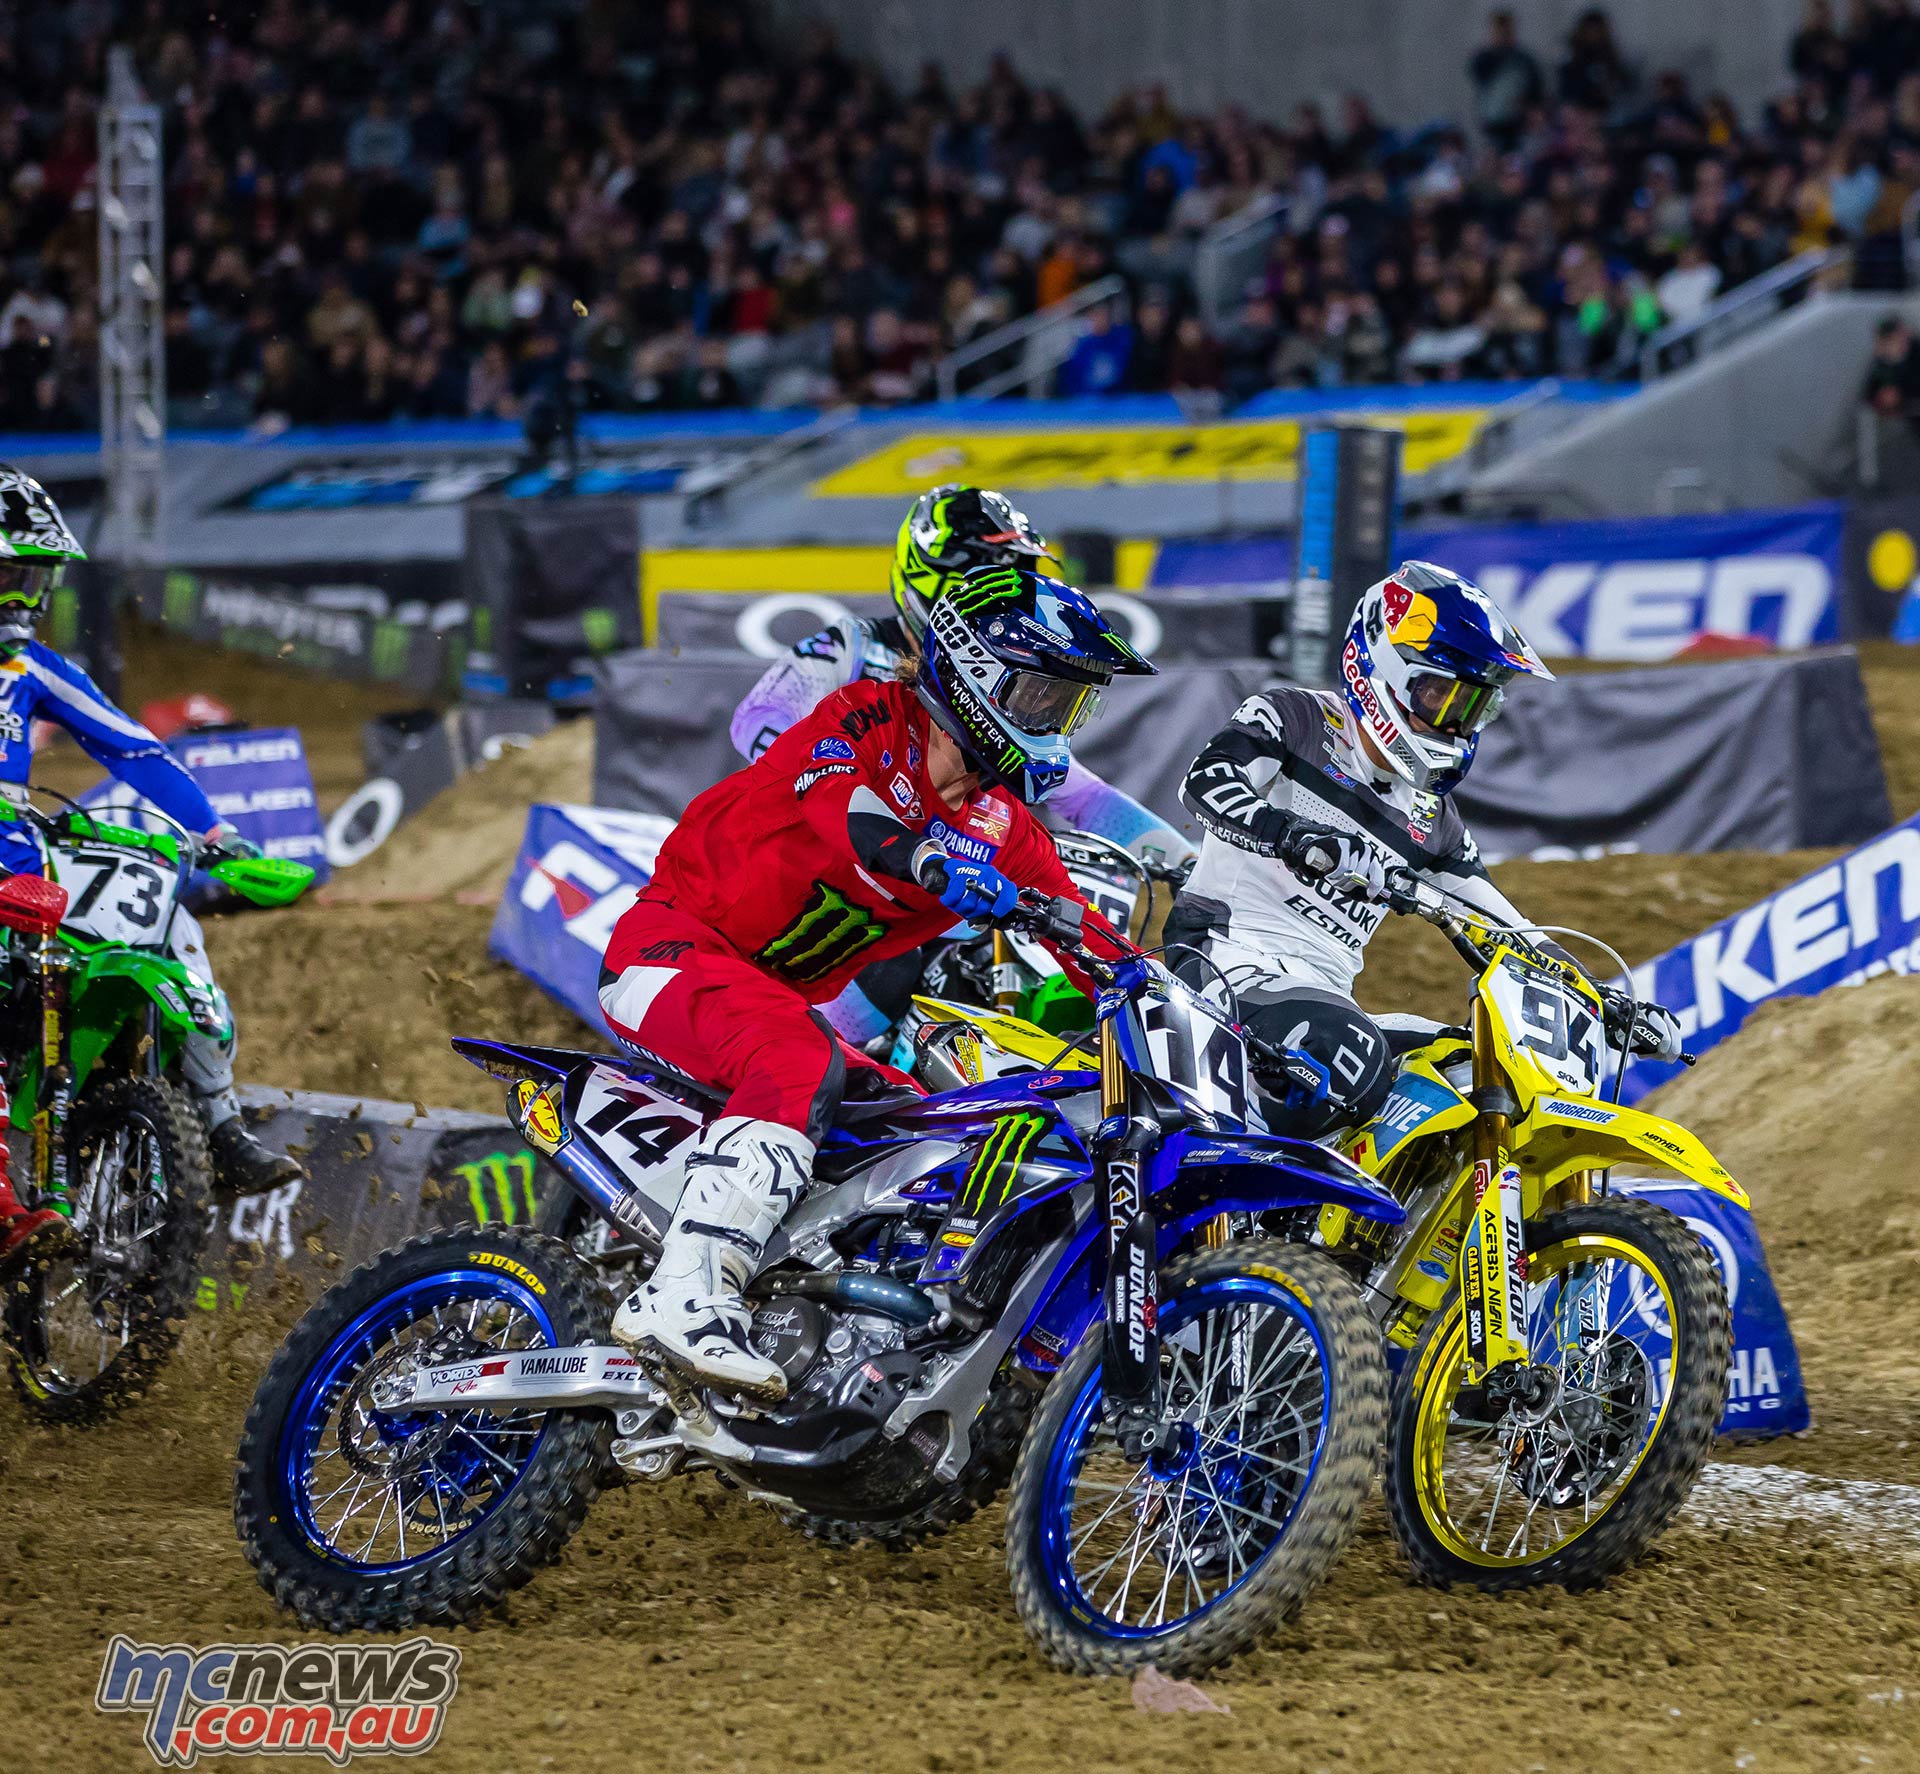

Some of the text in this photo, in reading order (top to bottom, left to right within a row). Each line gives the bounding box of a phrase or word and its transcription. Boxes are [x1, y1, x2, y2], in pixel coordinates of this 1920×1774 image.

[1474, 554, 1839, 661] KEN
[930, 600, 989, 681] 100%
[950, 680, 1006, 750] MONSTER
[951, 698, 990, 746] ENERGY
[893, 780, 914, 804] 100%
[943, 830, 991, 862] YAMAHA
[956, 866, 982, 877] THOR
[67, 854, 163, 928] 73
[1284, 894, 1362, 952] ECSTAR
[1516, 985, 1599, 1085] 94
[1632, 1025, 1662, 1047] ARC
[1145, 1003, 1247, 1127] 14
[1287, 1066, 1321, 1087] ARC
[582, 1086, 702, 1169] 14
[1544, 1100, 1618, 1125] PROGRESSIVE
[1641, 1130, 1686, 1156] MAYHEM
[477, 1251, 547, 1296] DUNLOP
[1467, 1246, 1480, 1301] GALFER
[1505, 1216, 1528, 1337] DUNLOP
[1129, 1243, 1146, 1364] DUNLOP
[520, 1357, 589, 1376] YAMALUBE
[601, 1370, 651, 1382] EXCE
